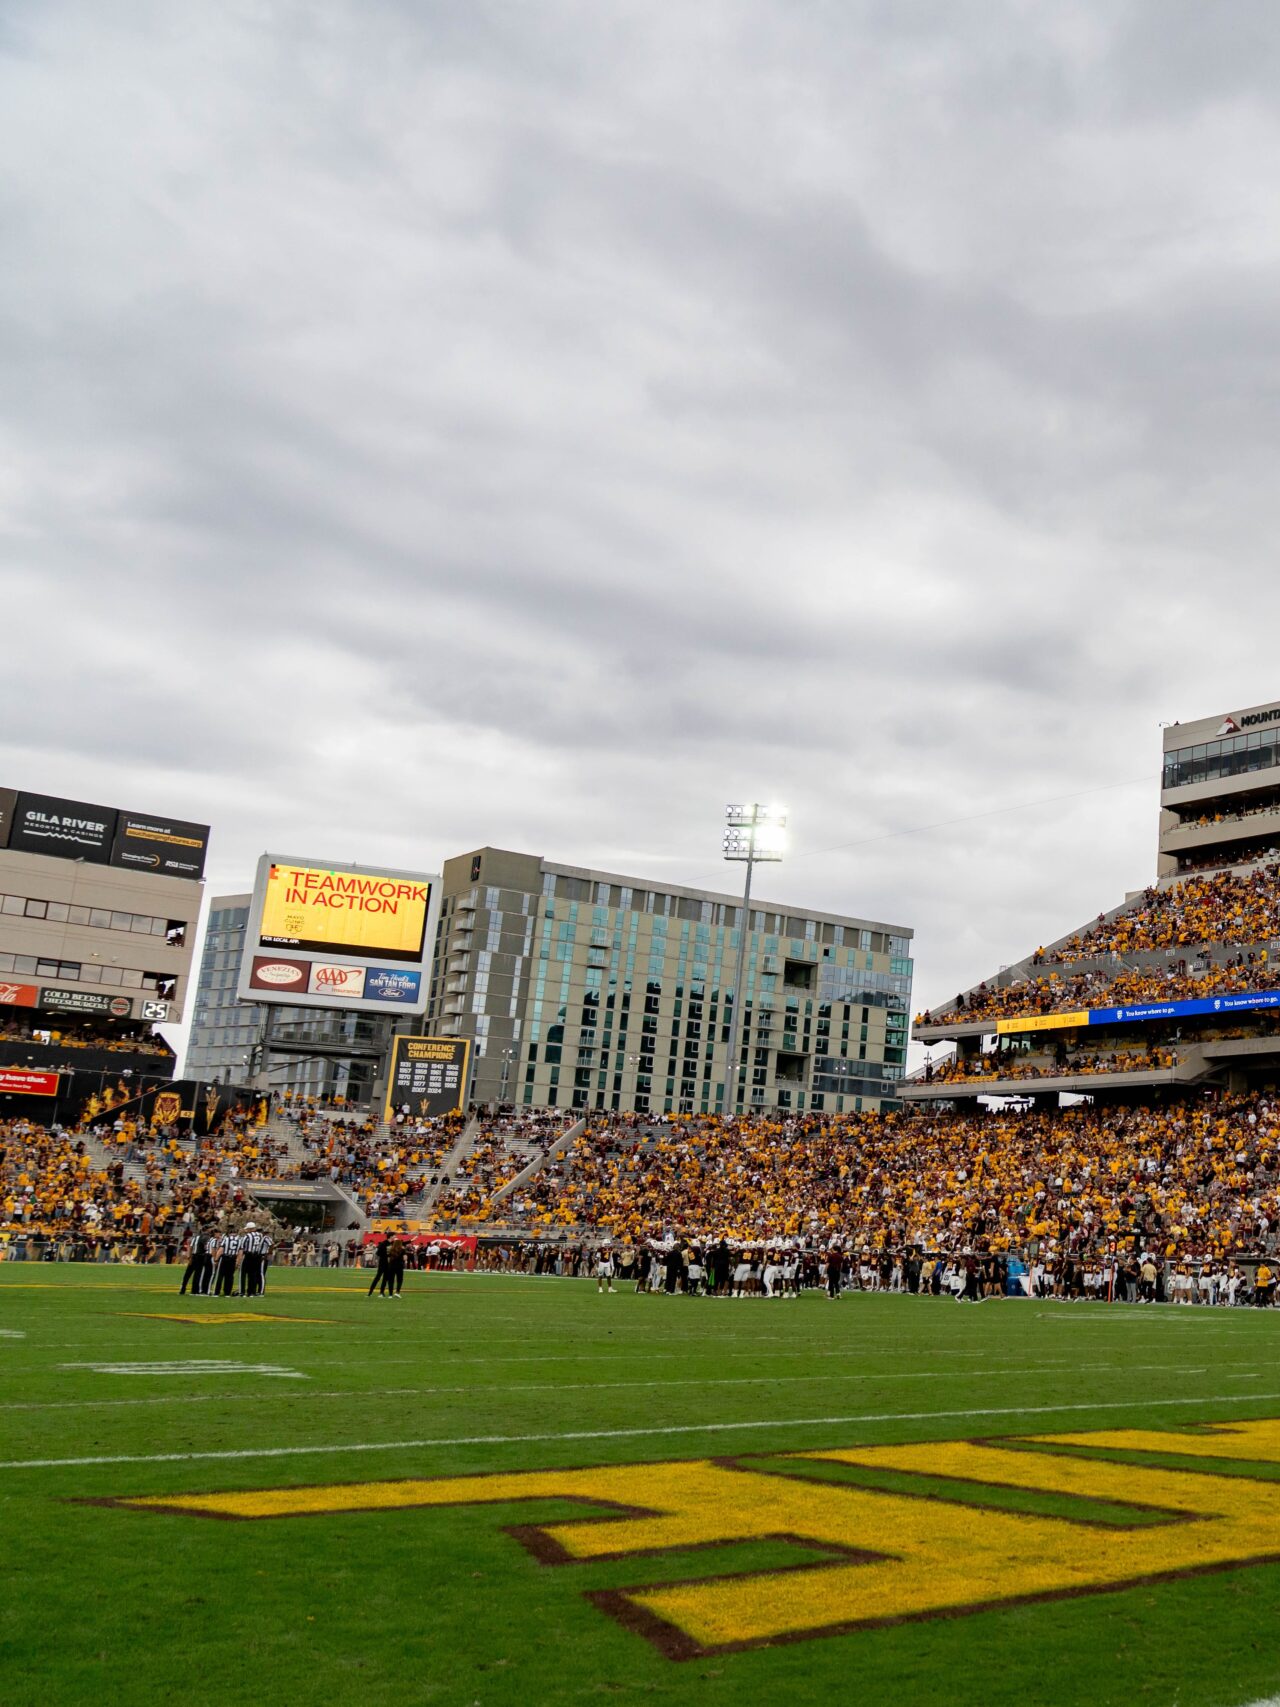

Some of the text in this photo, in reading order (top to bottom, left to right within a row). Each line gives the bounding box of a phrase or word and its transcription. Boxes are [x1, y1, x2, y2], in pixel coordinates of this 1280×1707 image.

[25, 810, 104, 833] GILA RIVER
[127, 821, 146, 830] Learn
[289, 871, 428, 902] TEAMWORK
[285, 888, 399, 915] IN ACTION
[317, 968, 347, 985] AAA
[370, 978, 416, 990] SAN TAN FORD
[44, 990, 70, 1000] COLD
[72, 993, 102, 1003] BEERS
[44, 998, 108, 1010] CHEESEBURGERS
[144, 1004, 166, 1018] 25
[408, 1042, 456, 1053] CONFERENCE
[408, 1050, 454, 1060] CHAMPIONS
[6, 1074, 25, 1082] have
[1110, 1241, 1116, 1252] 3
